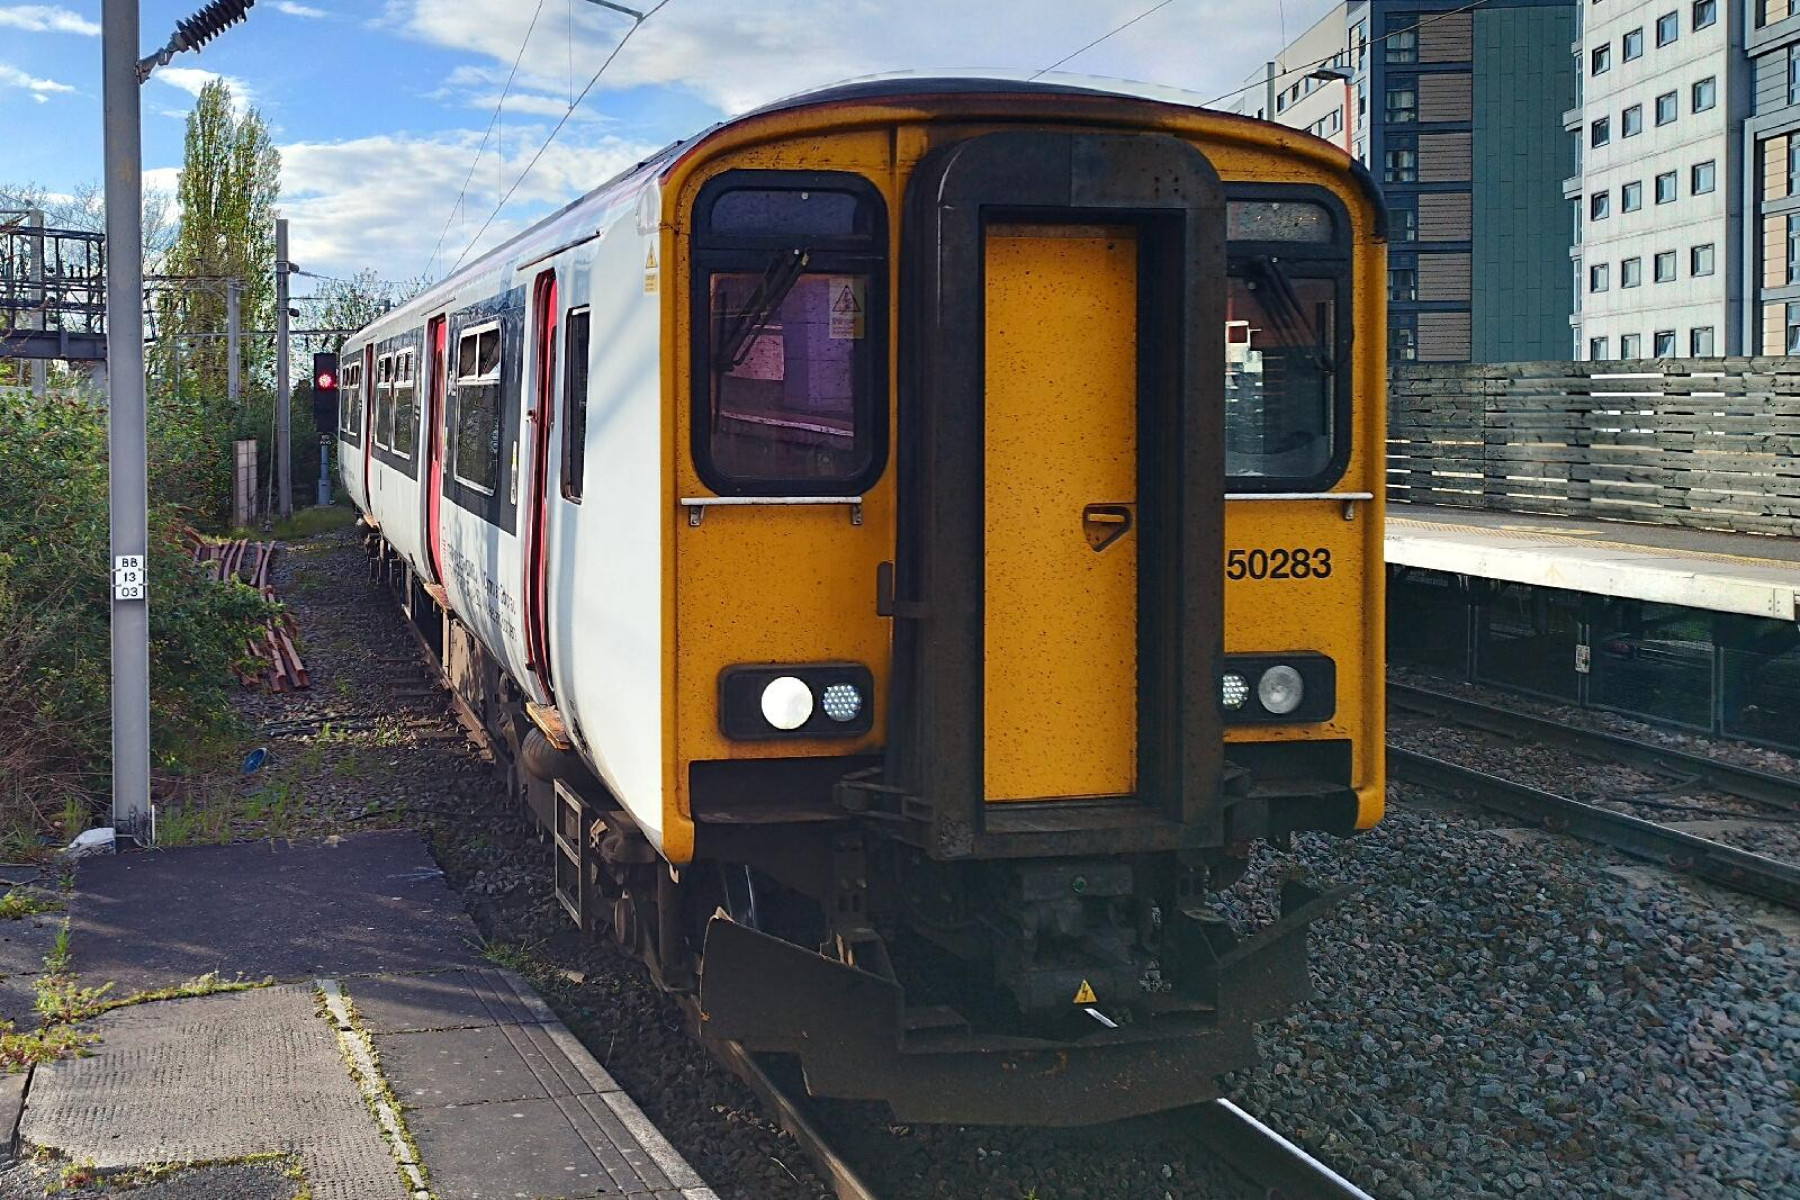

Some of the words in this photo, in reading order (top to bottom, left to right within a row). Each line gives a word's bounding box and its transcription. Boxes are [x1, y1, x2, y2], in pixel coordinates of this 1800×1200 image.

[122, 557, 138, 568] BB
[1226, 547, 1332, 580] 50283
[124, 571, 136, 582] 13
[121, 586, 138, 597] 03
